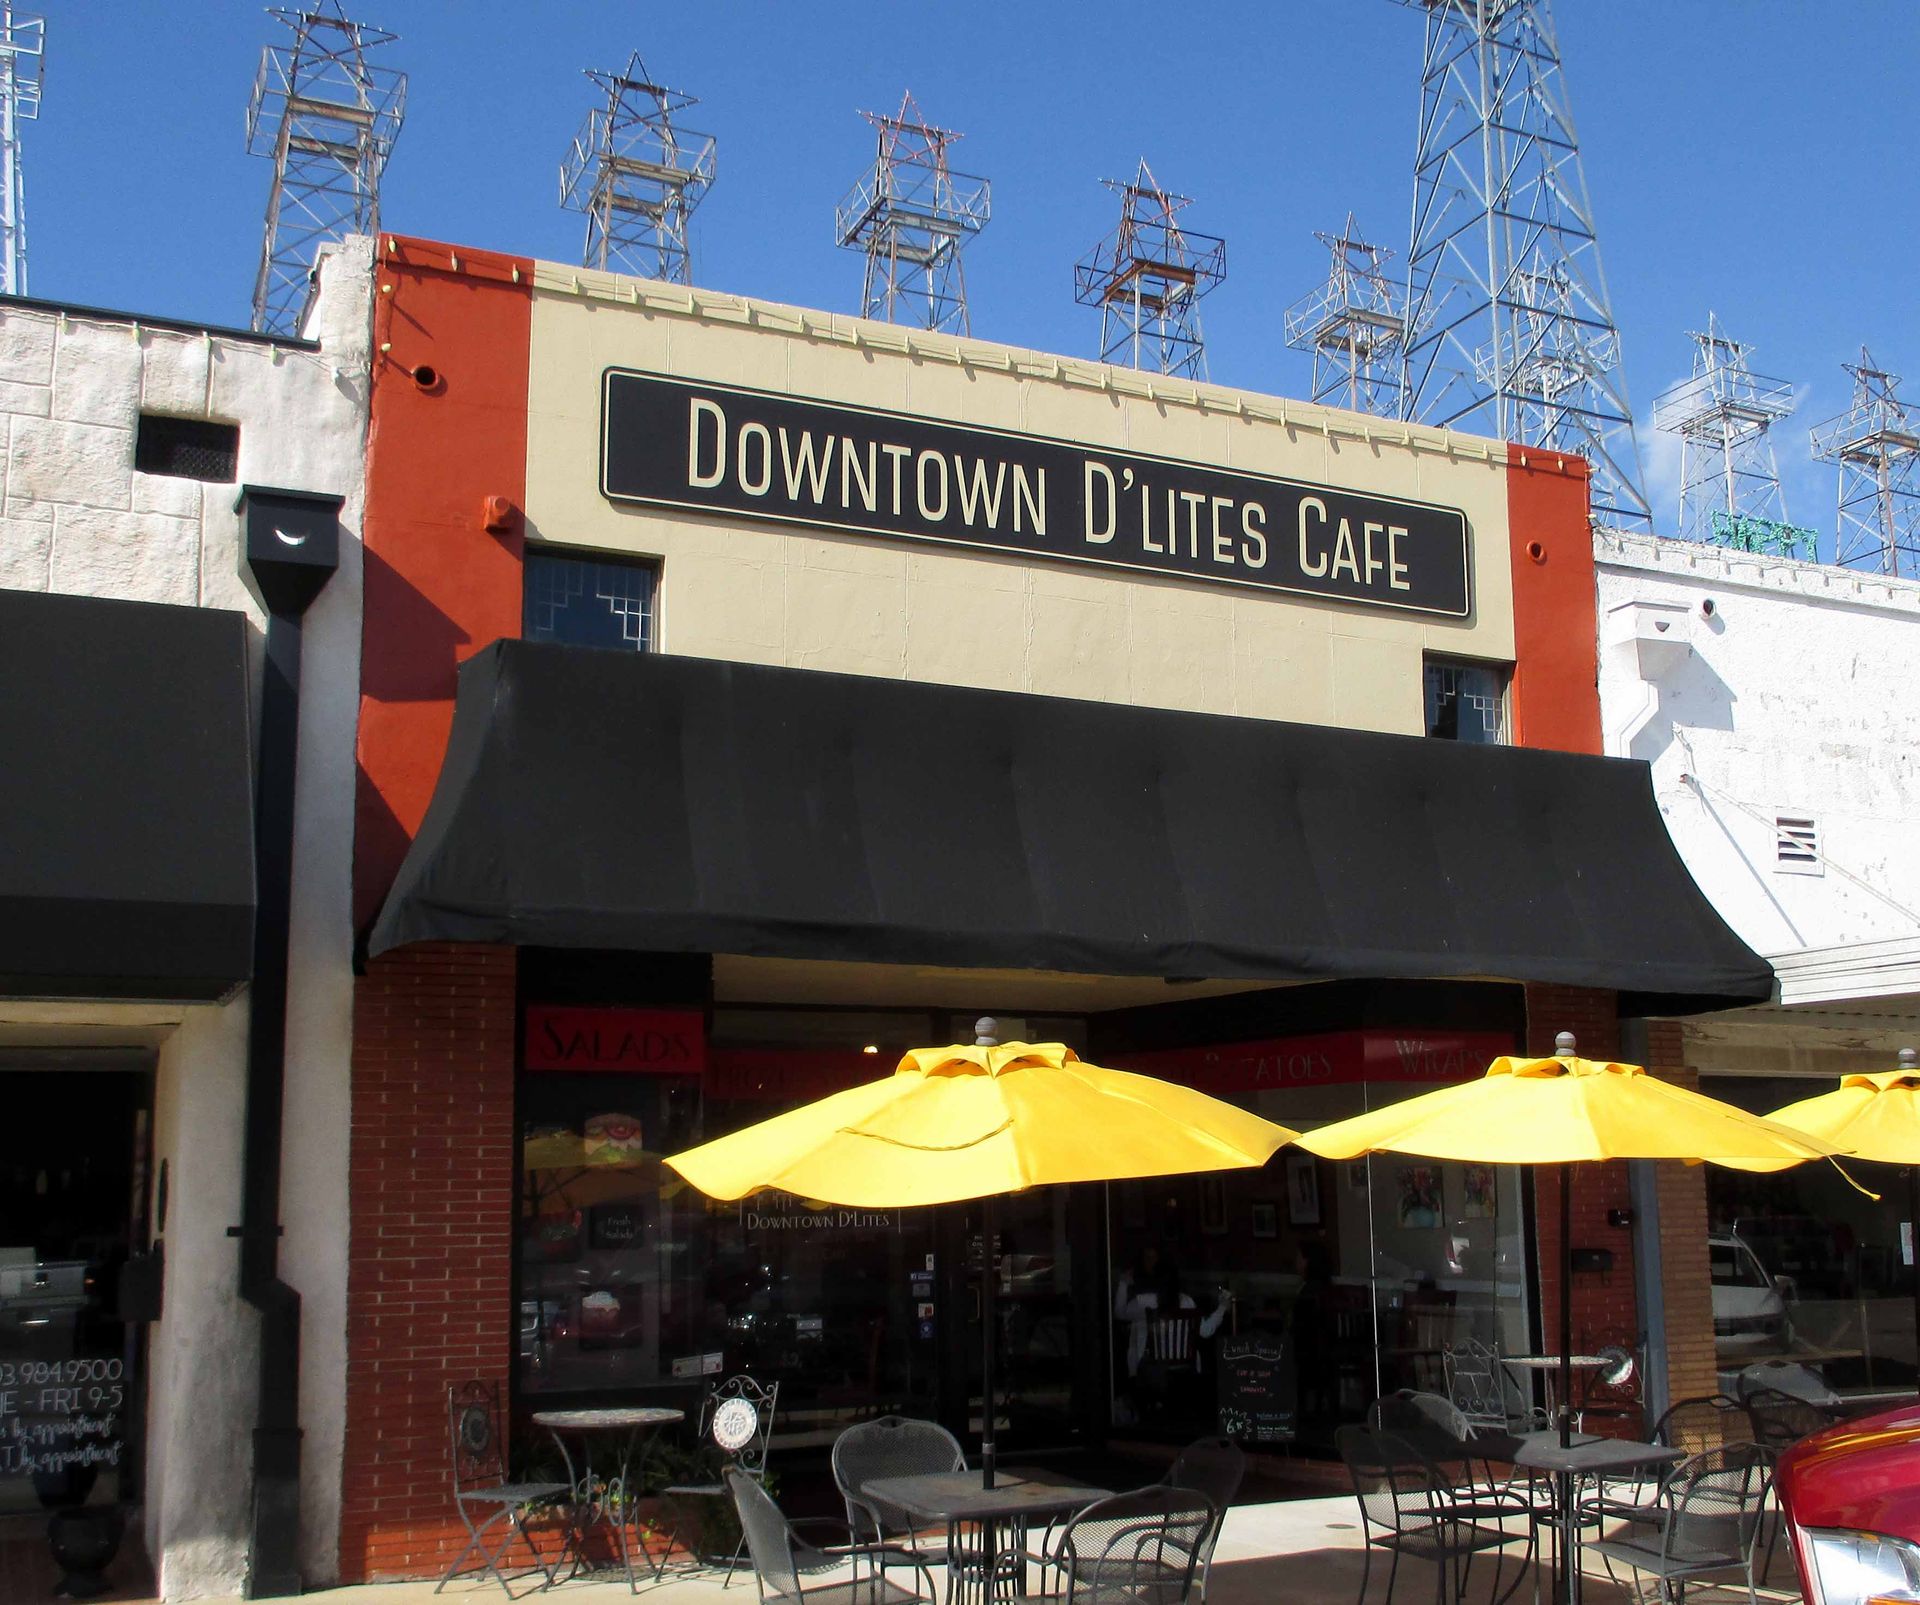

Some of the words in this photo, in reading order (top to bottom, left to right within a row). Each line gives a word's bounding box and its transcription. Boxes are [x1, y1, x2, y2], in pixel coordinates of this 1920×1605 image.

[1298, 496, 1411, 591] CAFE
[541, 1015, 692, 1064] SALADS
[746, 1212, 835, 1231] DOWNTOWN
[40, 1386, 83, 1415] FRI
